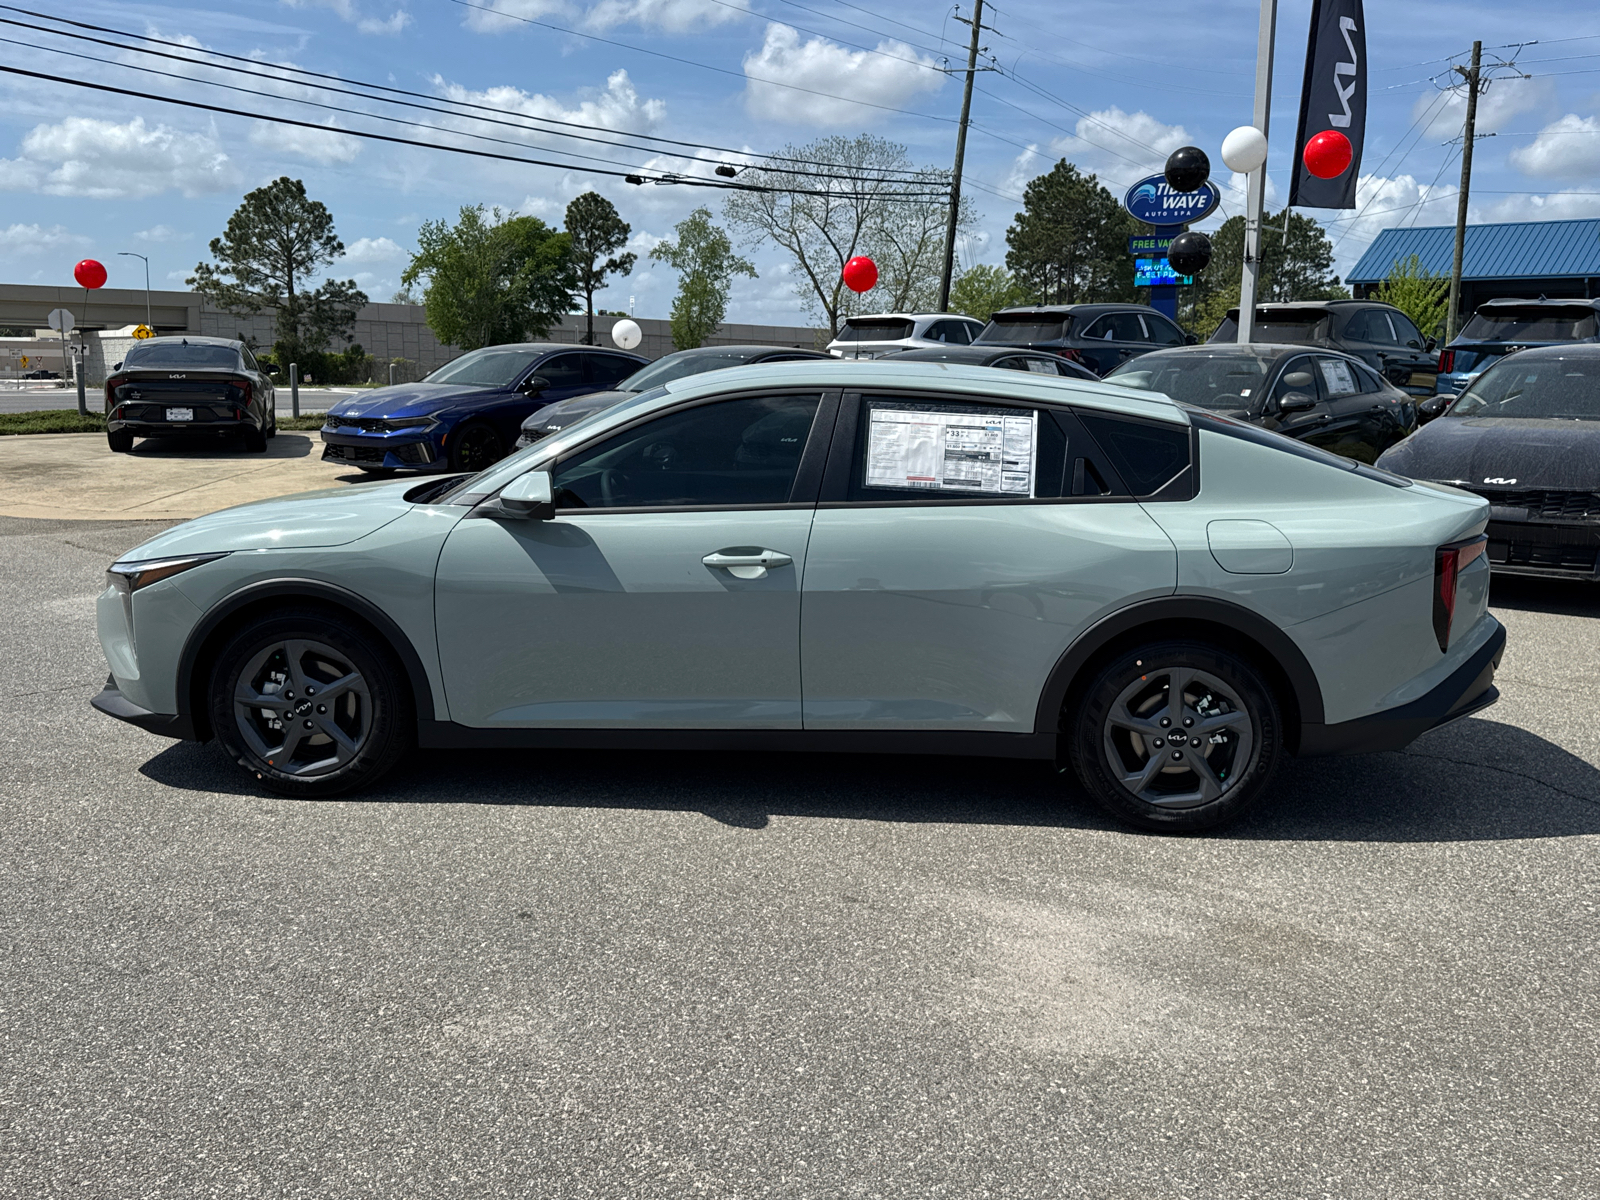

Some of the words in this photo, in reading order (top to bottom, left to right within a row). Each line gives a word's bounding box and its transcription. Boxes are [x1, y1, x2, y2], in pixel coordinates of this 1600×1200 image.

[1157, 182, 1199, 196] TID
[1162, 195, 1207, 209] WAVE
[1132, 239, 1155, 249] FREE
[1483, 477, 1517, 485] KIA
[1257, 715, 1275, 773] KUMHO
